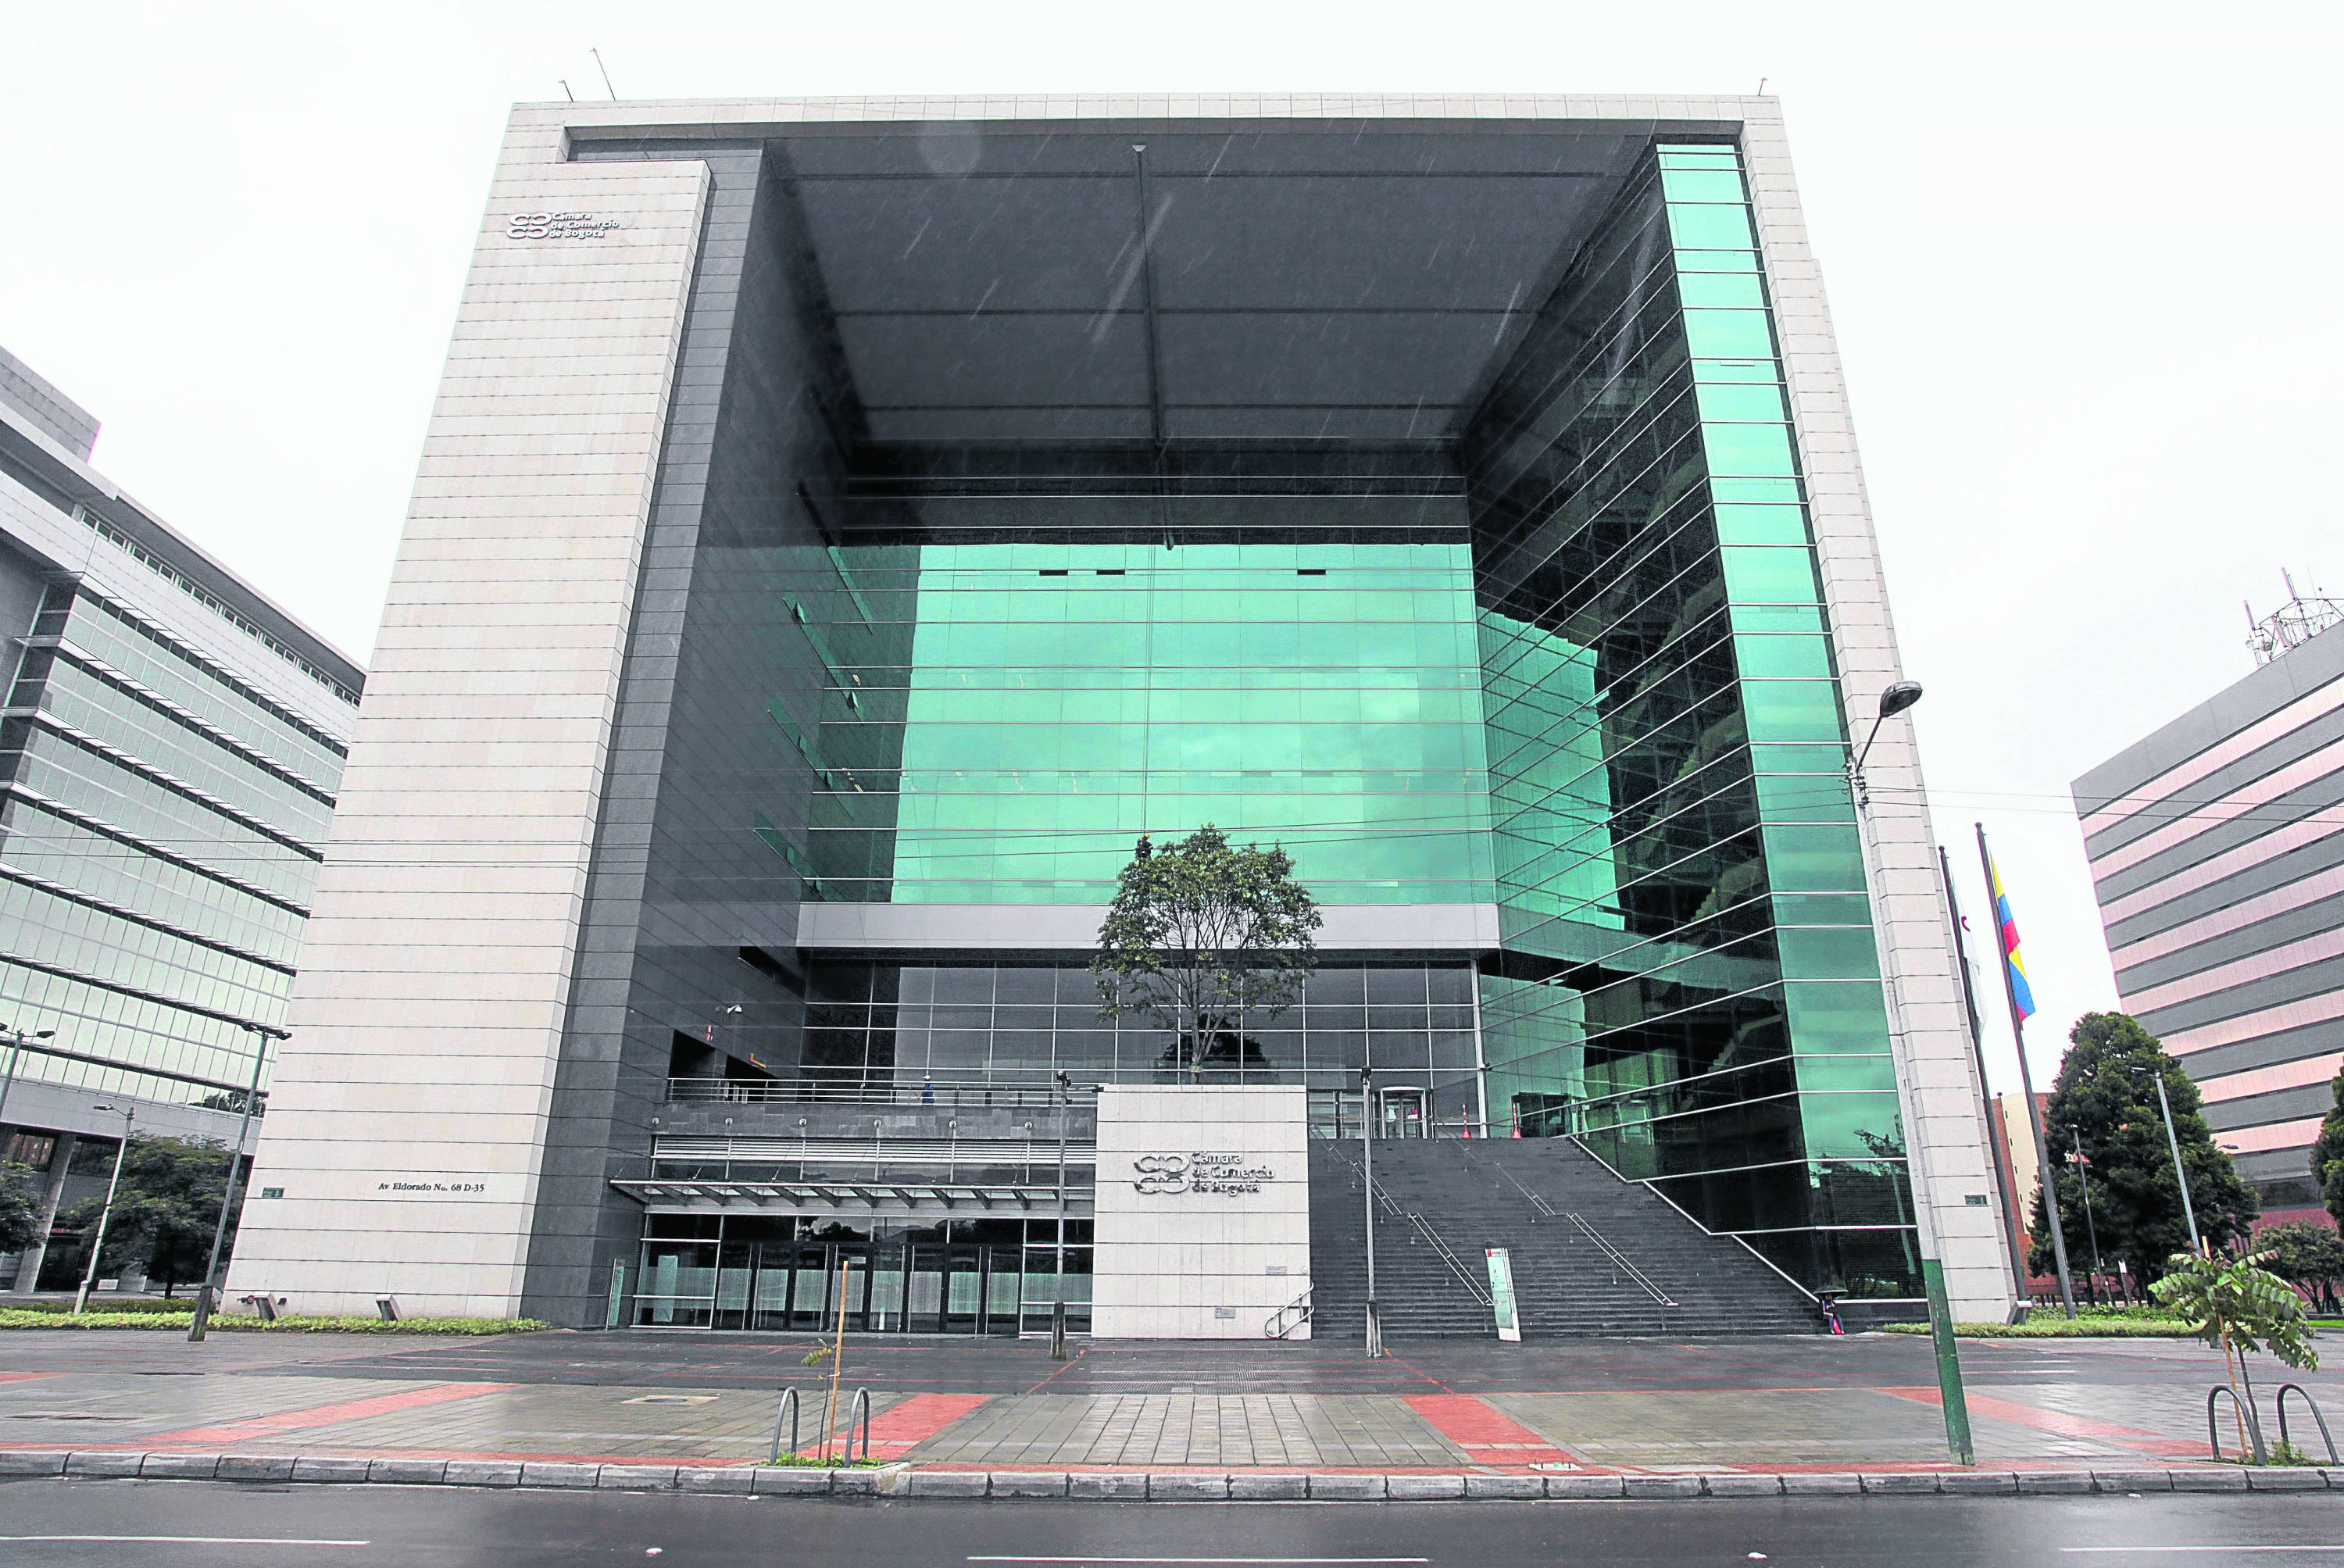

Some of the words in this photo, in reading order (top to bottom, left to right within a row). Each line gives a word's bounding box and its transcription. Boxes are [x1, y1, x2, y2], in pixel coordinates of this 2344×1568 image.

[551, 221, 564, 230] de
[567, 219, 620, 229] Comercio
[549, 229, 563, 238] de
[565, 227, 605, 239] Bogotá
[1192, 1151, 1242, 1164] Cámara
[1192, 1166, 1208, 1178] de
[1211, 1166, 1275, 1179] Comercio
[463, 1184, 484, 1192] D-35
[1192, 1179, 1208, 1192] de
[1211, 1180, 1260, 1197] Bogotá
